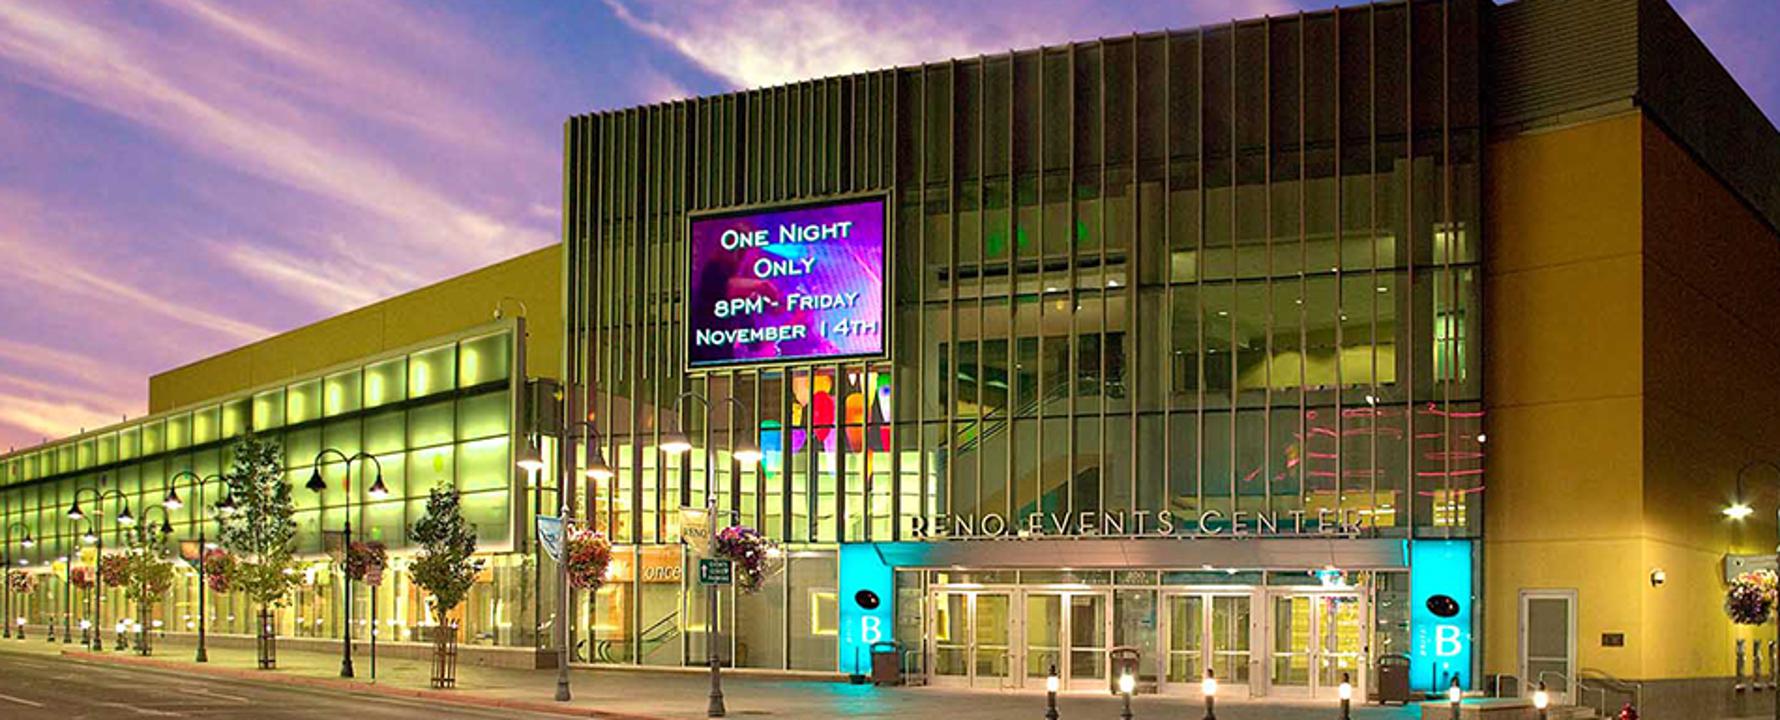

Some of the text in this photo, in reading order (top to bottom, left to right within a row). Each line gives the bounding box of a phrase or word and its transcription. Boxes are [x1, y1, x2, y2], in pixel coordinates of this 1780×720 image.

[721, 222, 852, 250] ONE NIGHT
[754, 257, 816, 278] ONLY
[787, 292, 860, 311] FRIDAY
[696, 324, 806, 346] NOVEMBER
[911, 509, 1363, 537] RENO EVENTS CENTER
[861, 615, 881, 644] B
[1435, 625, 1462, 657] B
